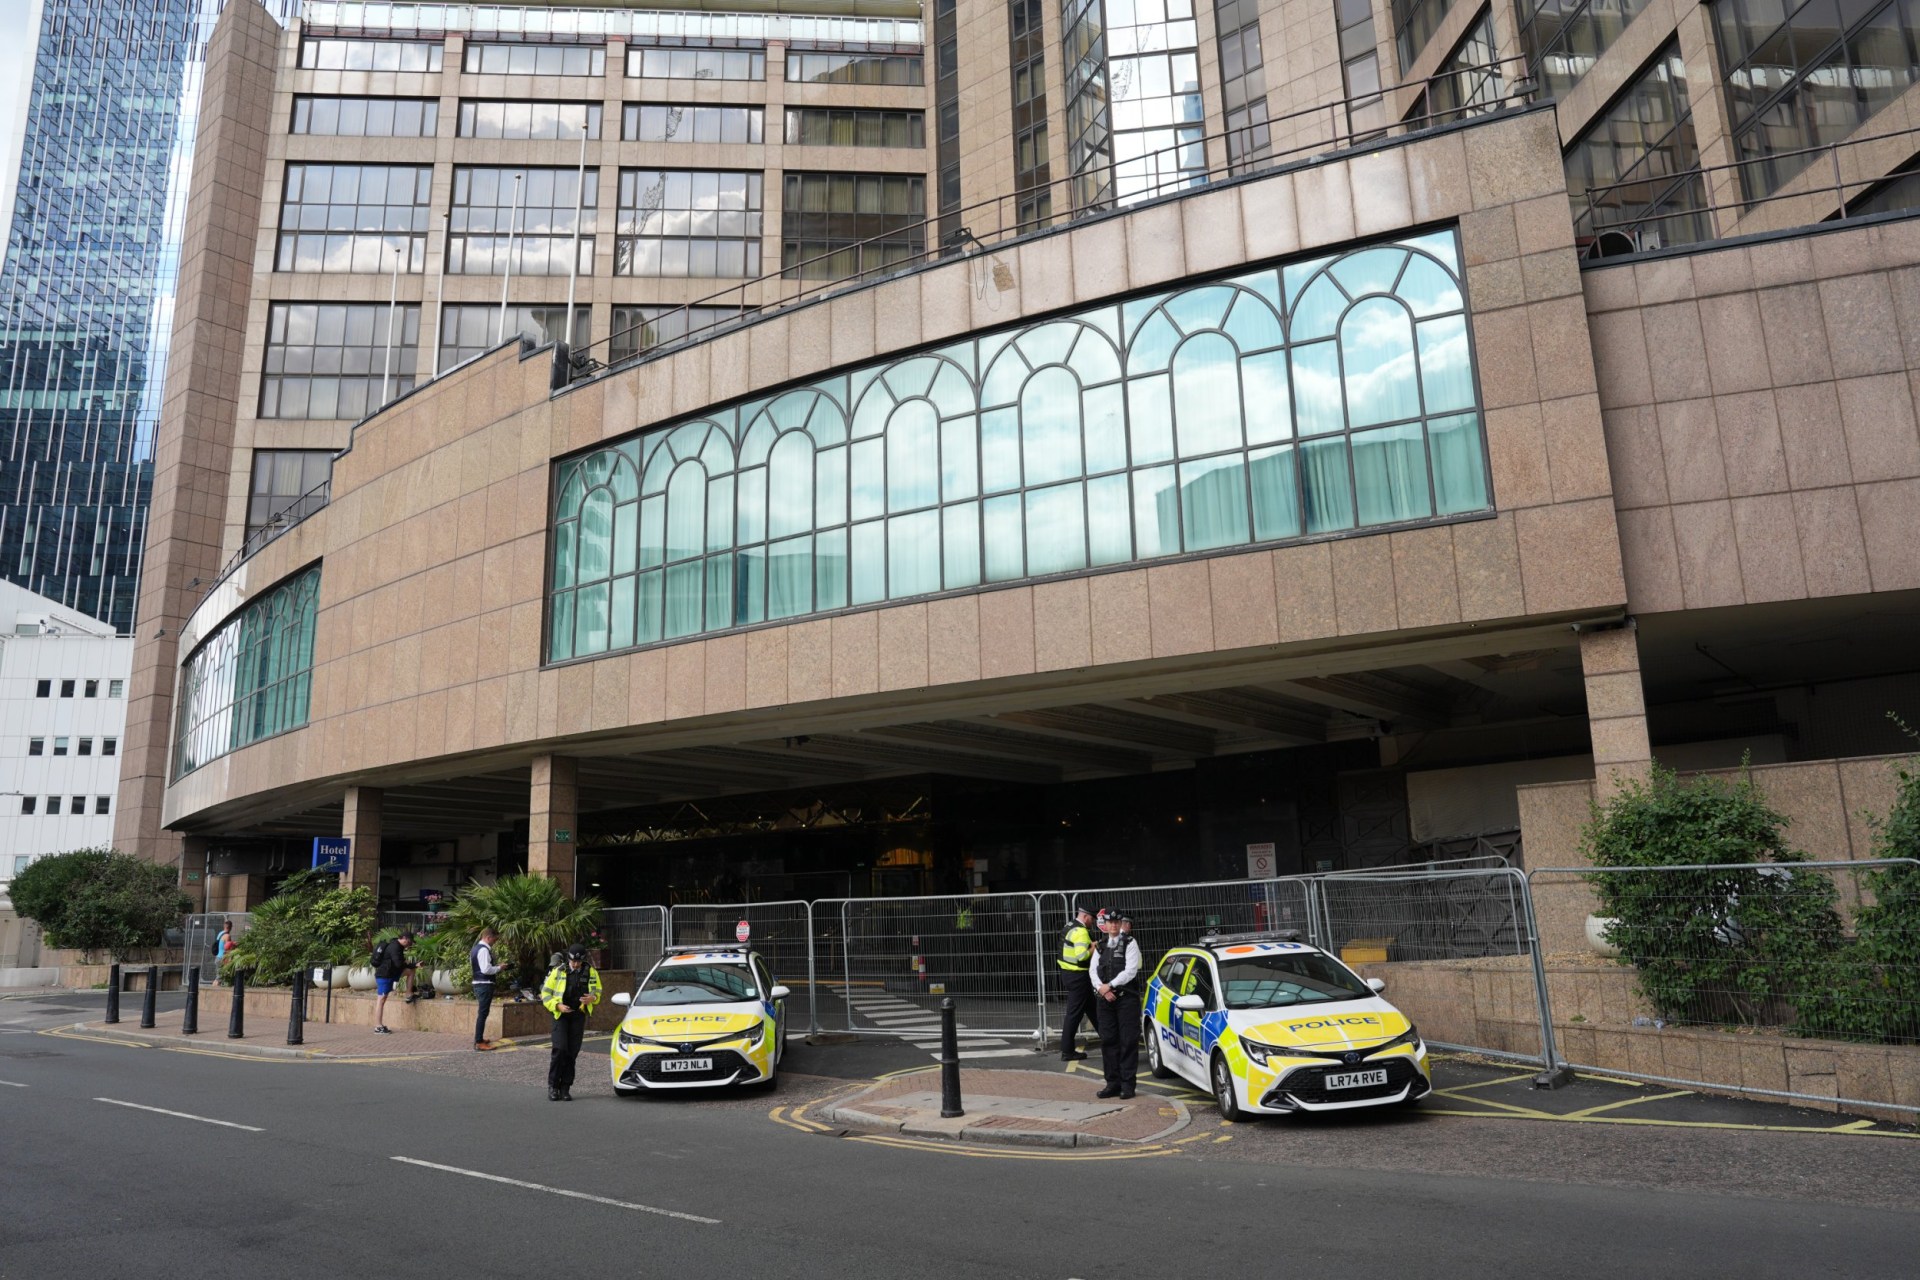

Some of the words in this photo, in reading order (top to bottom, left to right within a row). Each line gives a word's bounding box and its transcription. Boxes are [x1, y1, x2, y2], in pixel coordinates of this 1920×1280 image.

[320, 845, 347, 855] Hotel
[653, 1016, 727, 1025] POLICE
[1288, 1016, 1380, 1032] POLICE
[1161, 1026, 1204, 1068] POLICE
[664, 1060, 689, 1071] LM73
[690, 1059, 709, 1069] NLA
[1329, 1074, 1360, 1088] LR74
[1362, 1071, 1383, 1084] RVE
